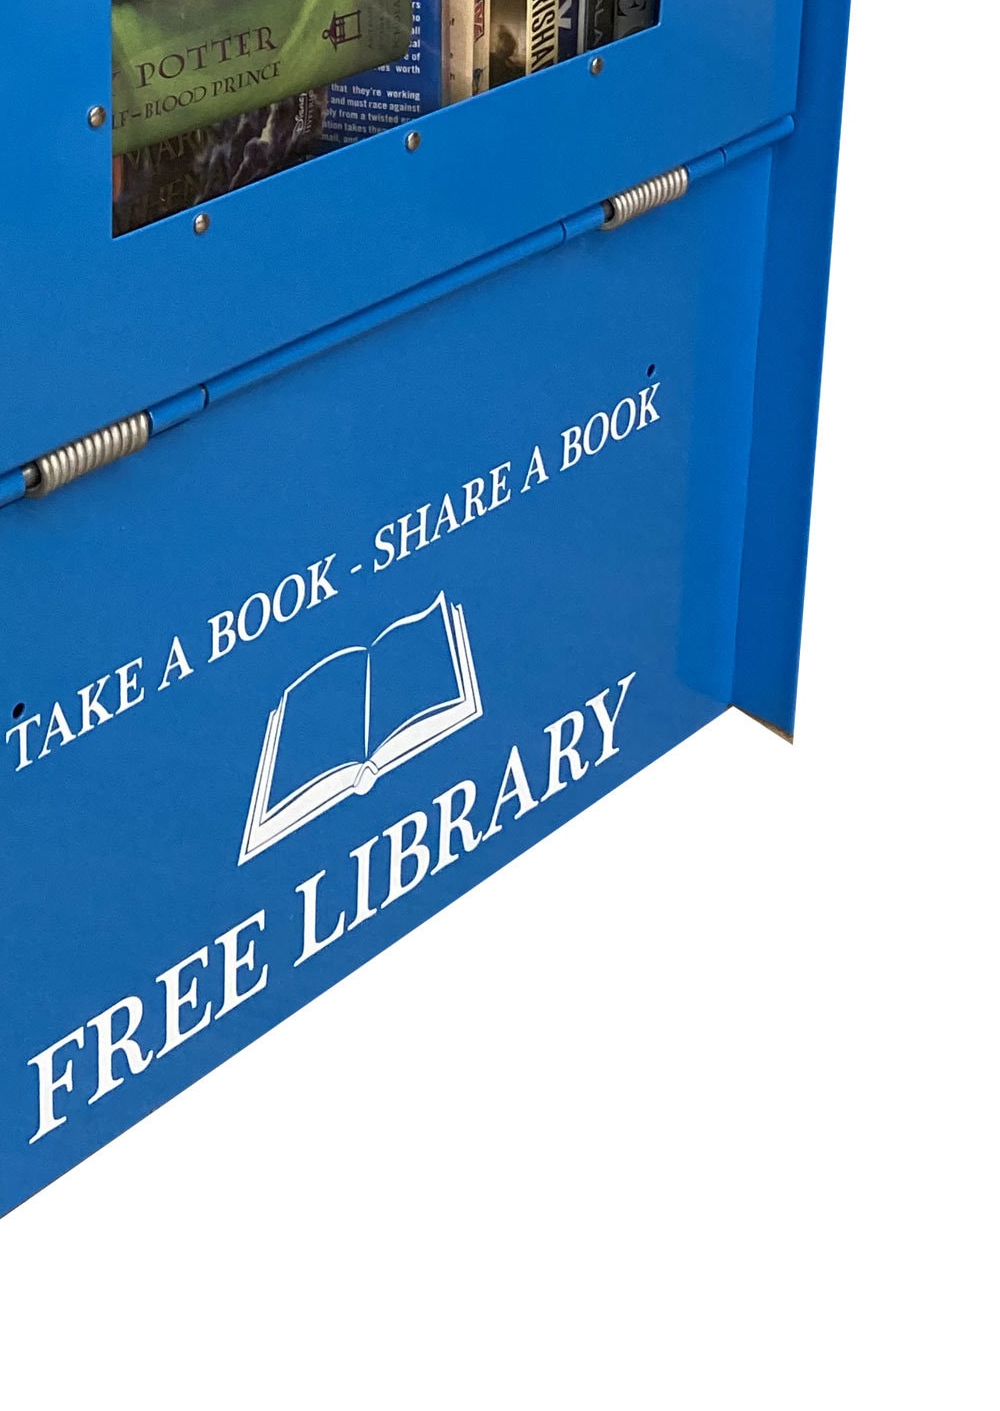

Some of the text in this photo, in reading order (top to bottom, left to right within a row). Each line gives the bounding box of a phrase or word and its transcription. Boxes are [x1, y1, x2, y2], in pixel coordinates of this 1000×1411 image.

[135, 26, 278, 88] POTTER
[411, 53, 420, 61] of
[395, 65, 421, 74] worth
[112, 61, 281, 130] LF-BLOOD PRINCE
[331, 83, 420, 101] that they're working
[331, 96, 420, 113] and must race against
[339, 109, 359, 119] from
[368, 112, 399, 123] twisted
[344, 123, 367, 134] takes
[6, 657, 144, 772] TAKE
[159, 634, 195, 683] A
[207, 553, 338, 664] BOOK
[373, 461, 514, 574] SHARE
[520, 445, 551, 492] A
[560, 382, 663, 470] BOOK
[27, 671, 637, 1146] FREE LIBRARY
